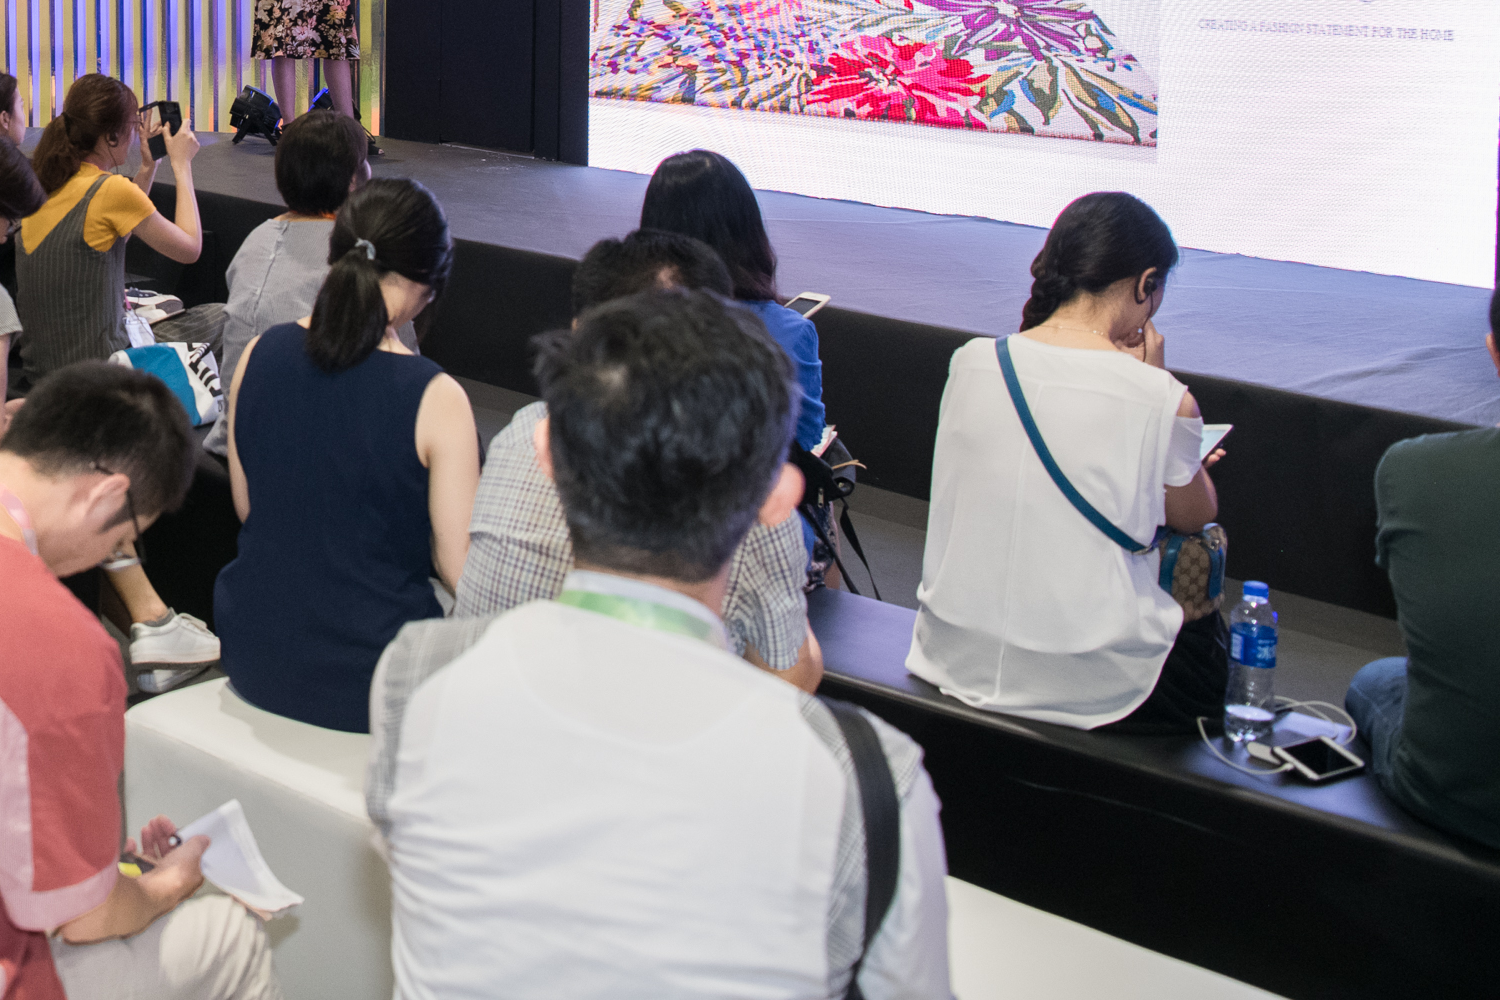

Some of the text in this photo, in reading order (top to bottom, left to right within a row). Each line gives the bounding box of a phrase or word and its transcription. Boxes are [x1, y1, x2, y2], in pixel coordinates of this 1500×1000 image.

[1198, 17, 1248, 31] CREATING
[1306, 23, 1368, 38] STATEMENT
[1372, 26, 1393, 38] FOR
[1397, 27, 1418, 39] THE
[1420, 28, 1454, 41] HOME
